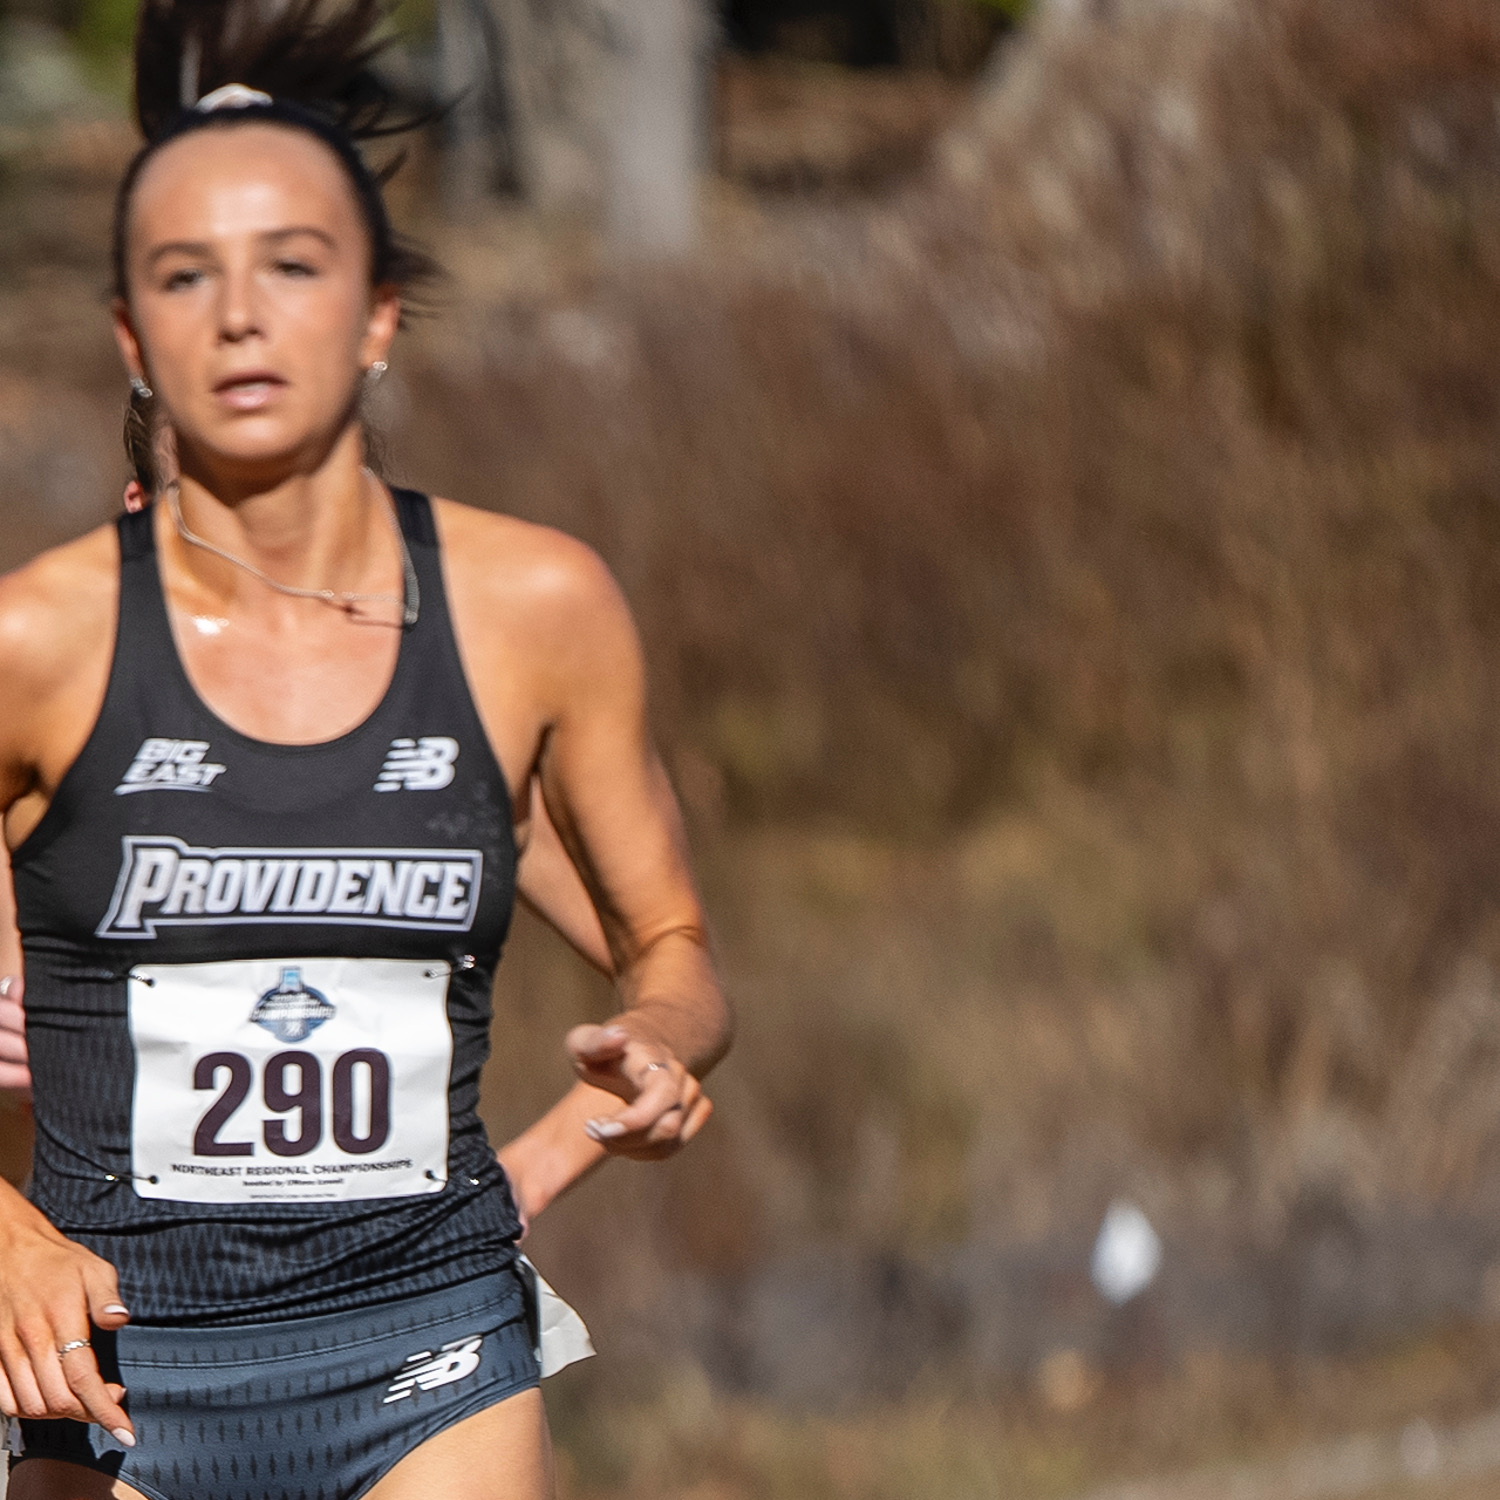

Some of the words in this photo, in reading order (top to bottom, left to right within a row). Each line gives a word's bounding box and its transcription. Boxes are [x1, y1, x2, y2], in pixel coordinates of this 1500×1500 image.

[139, 737, 211, 763] BIG
[373, 736, 460, 792] NB
[121, 763, 228, 786] EAST
[114, 848, 474, 929] PROVIDENCE
[193, 1047, 391, 1157] 290
[170, 1163, 242, 1176] NORTHEAST
[246, 1164, 310, 1176] REGIONAL
[313, 1159, 413, 1175] CHAMPIONSHIPS
